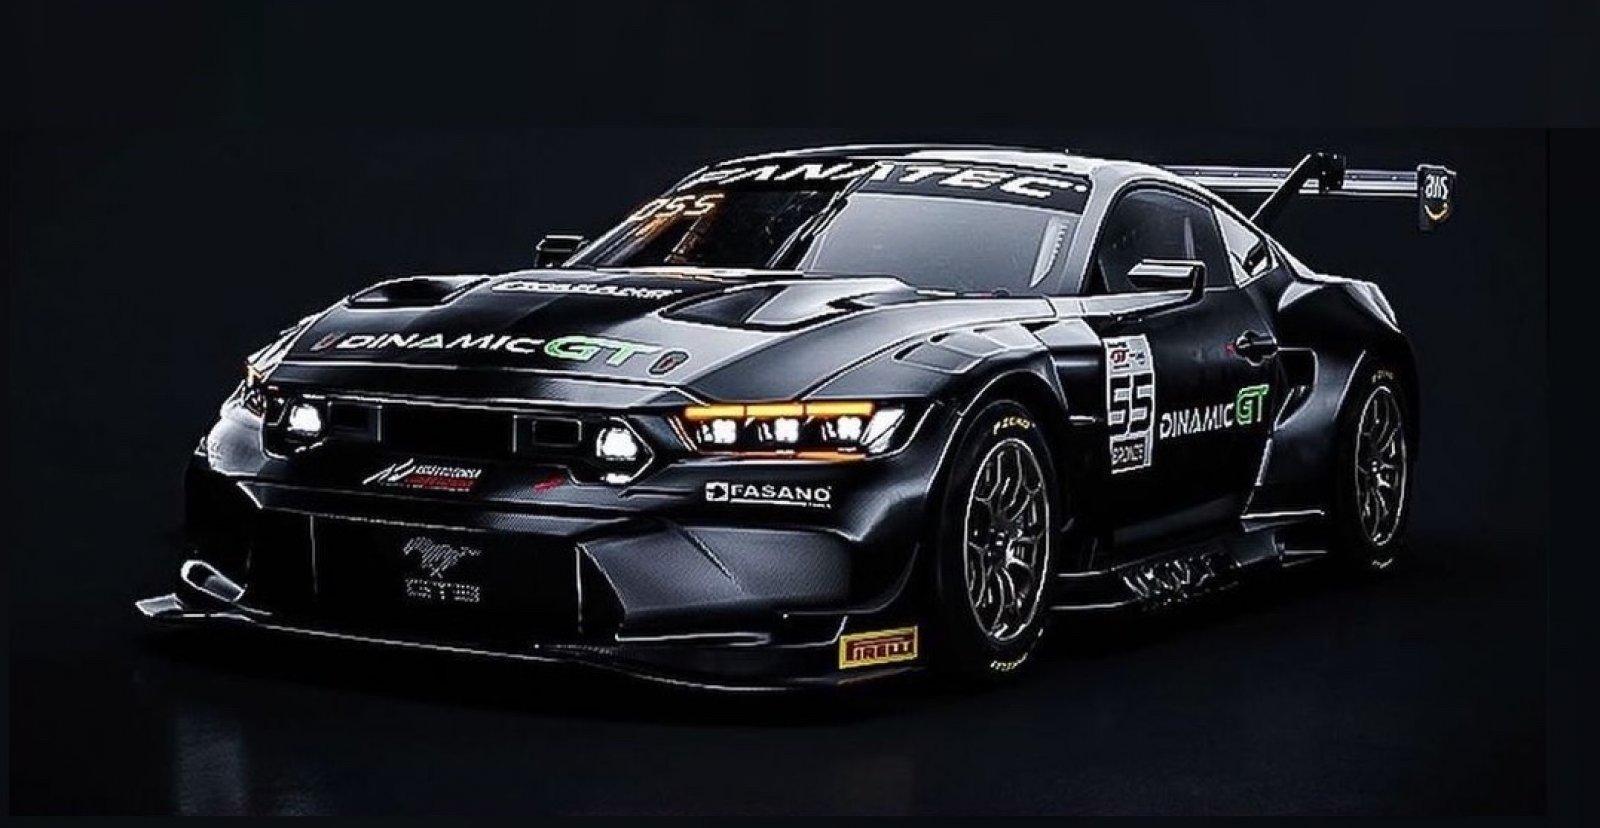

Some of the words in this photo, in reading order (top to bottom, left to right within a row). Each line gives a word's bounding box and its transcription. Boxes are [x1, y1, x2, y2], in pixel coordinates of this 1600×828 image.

[677, 162, 1074, 198] FANATEC
[337, 334, 544, 353] DINAMIC
[544, 335, 664, 366] GT
[1108, 374, 1154, 436] 55
[1159, 403, 1234, 440] DINAMIC
[1235, 383, 1270, 426] GT
[730, 484, 830, 502] FASANO
